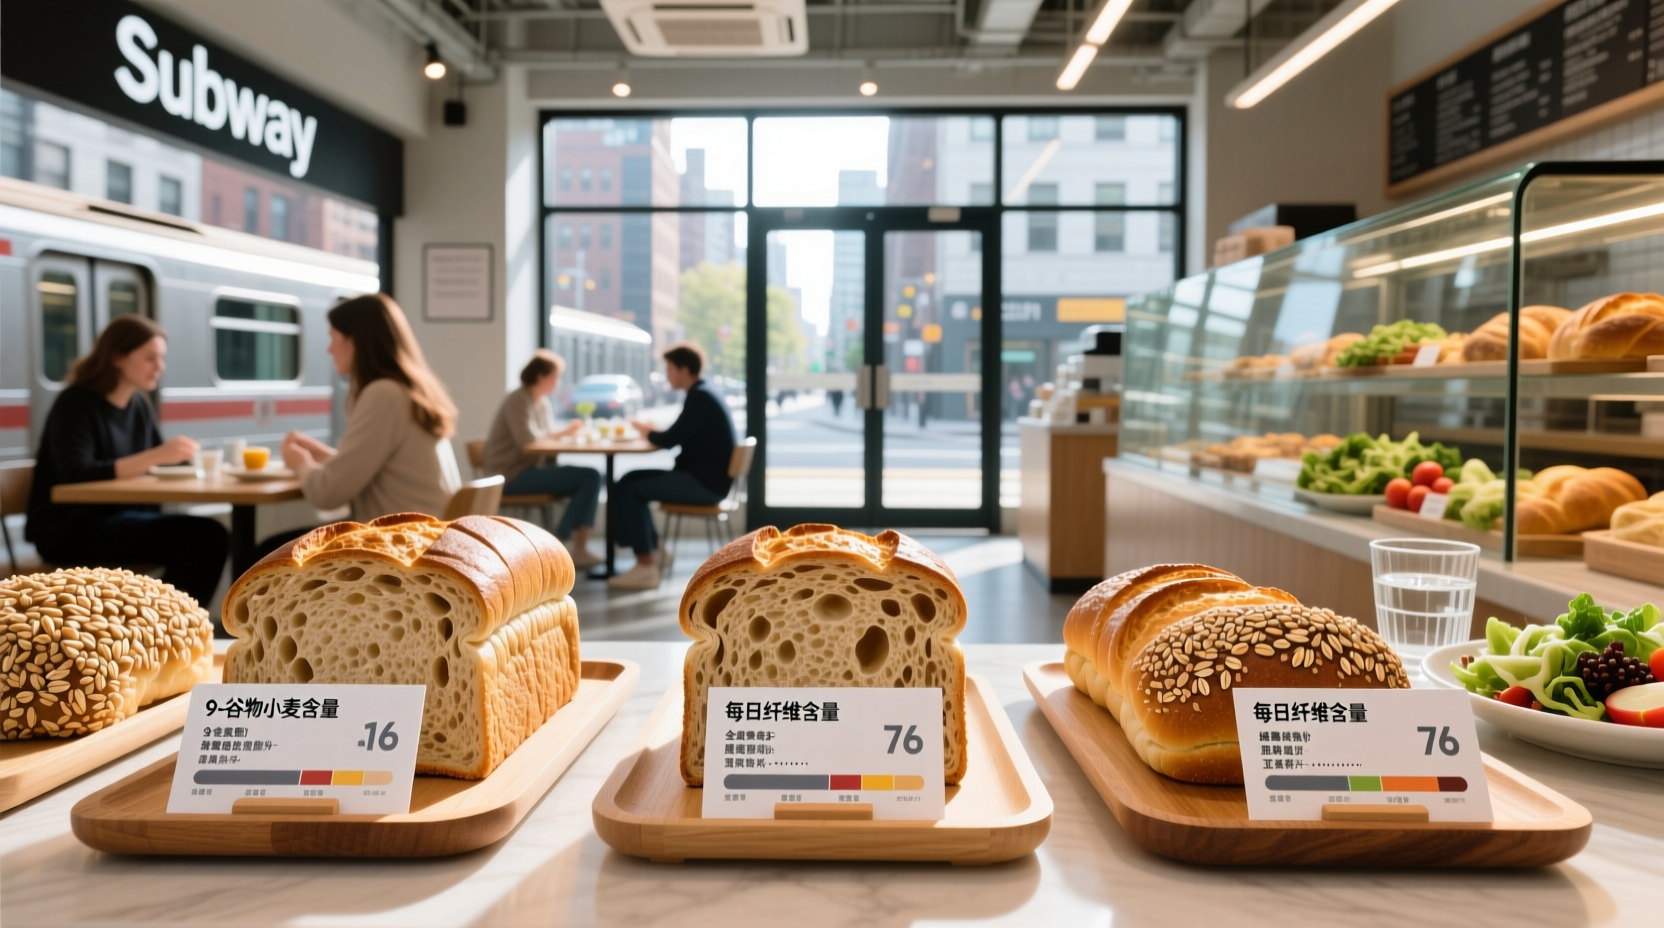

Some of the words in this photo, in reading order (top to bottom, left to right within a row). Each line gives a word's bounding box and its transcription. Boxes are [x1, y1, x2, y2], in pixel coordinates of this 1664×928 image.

[113, 15, 318, 178] Subway
[205, 696, 340, 719] 9-谷物小麦含量
[725, 700, 840, 722] 每日纤维含量
[1253, 701, 1368, 723] 每日纤维含量
[364, 721, 399, 752] 16
[883, 724, 924, 755] 76
[1417, 726, 1460, 756] 76
